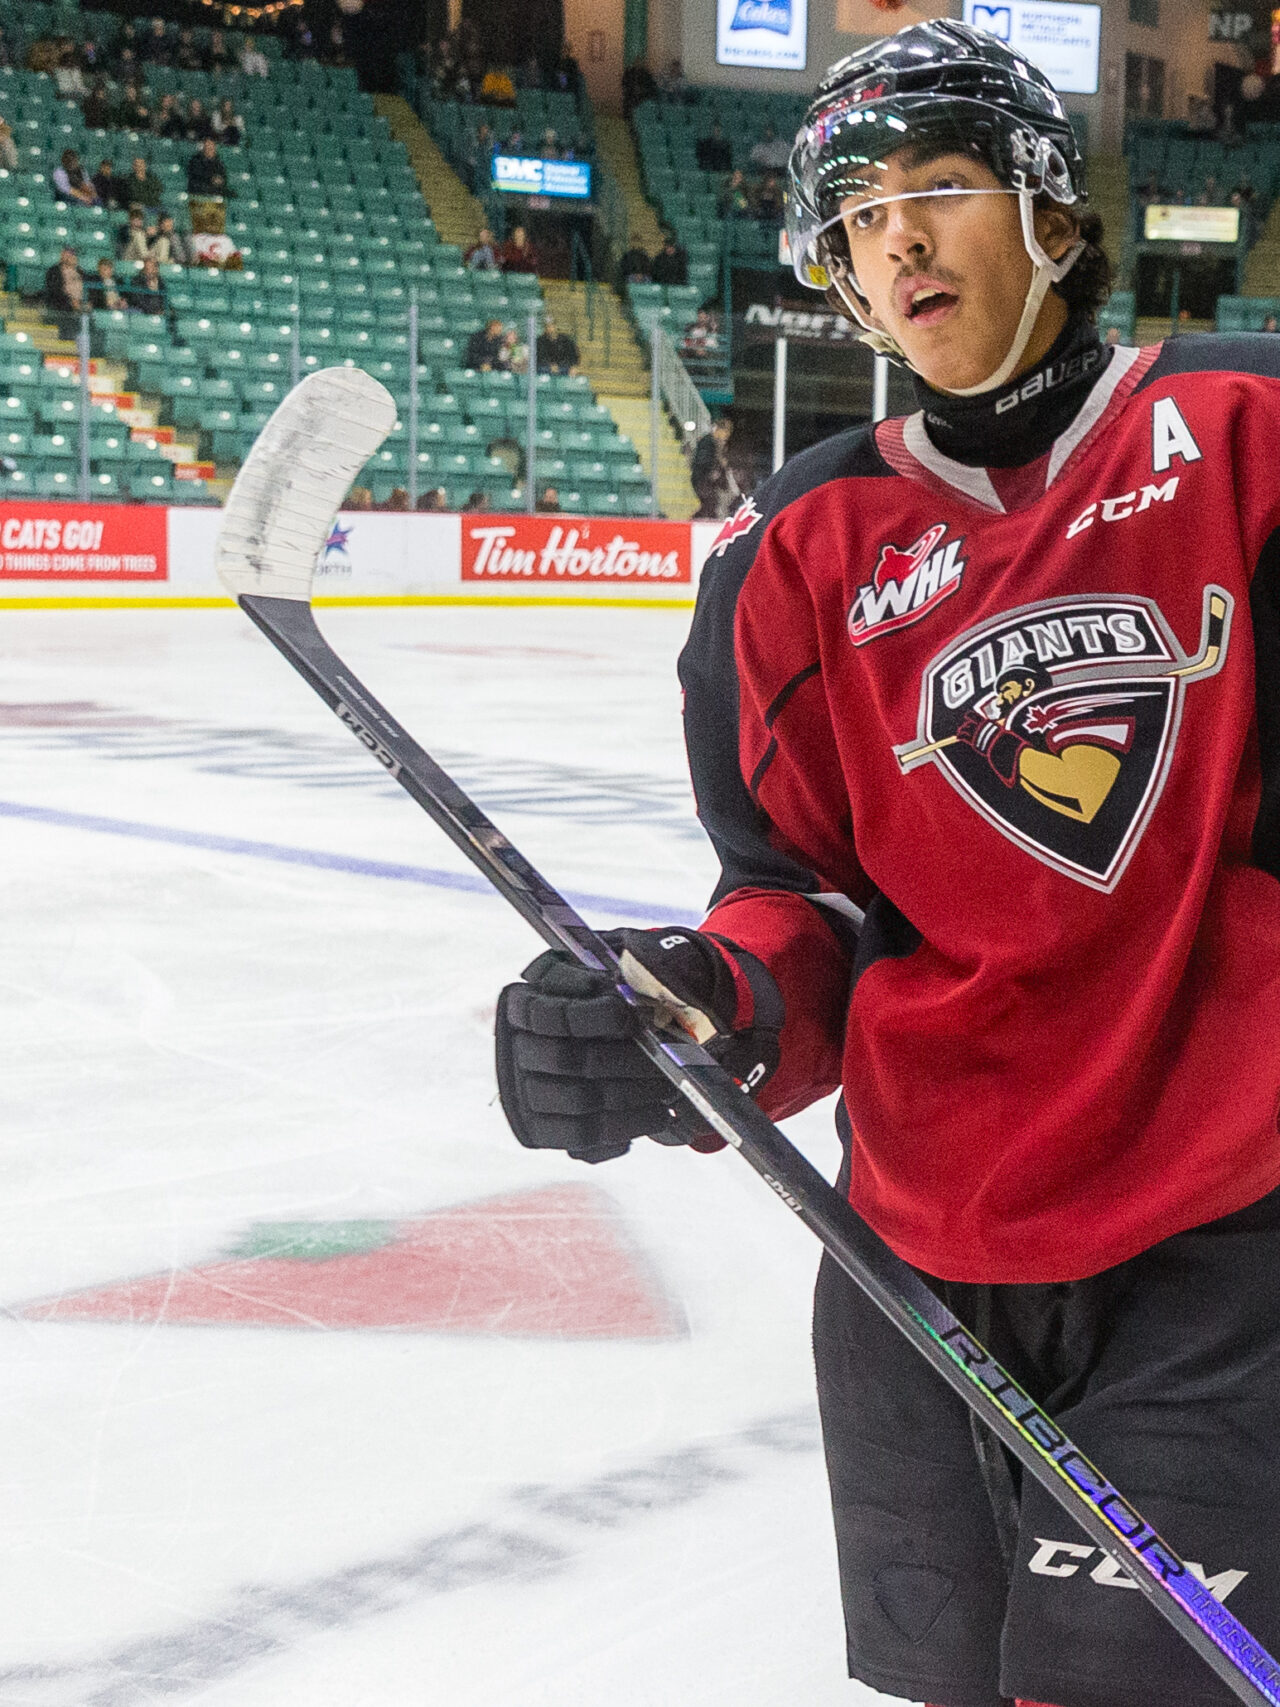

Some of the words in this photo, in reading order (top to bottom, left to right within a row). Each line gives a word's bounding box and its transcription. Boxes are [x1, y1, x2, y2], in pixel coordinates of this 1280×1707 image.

[1152, 396, 1203, 475] A
[3, 518, 62, 550] CATS
[63, 520, 104, 550] GO!
[1066, 476, 1179, 540] CCM
[5, 554, 50, 571] THINGS
[52, 555, 85, 571] COME
[87, 555, 121, 571] FROM
[122, 555, 157, 572] TREES
[470, 526, 535, 576] Tim
[540, 526, 682, 577] Hortons
[861, 539, 966, 627] WHL
[941, 613, 1147, 709] GIANTS
[341, 710, 396, 772] CCM
[941, 1326, 1186, 1581] RIBCOR
